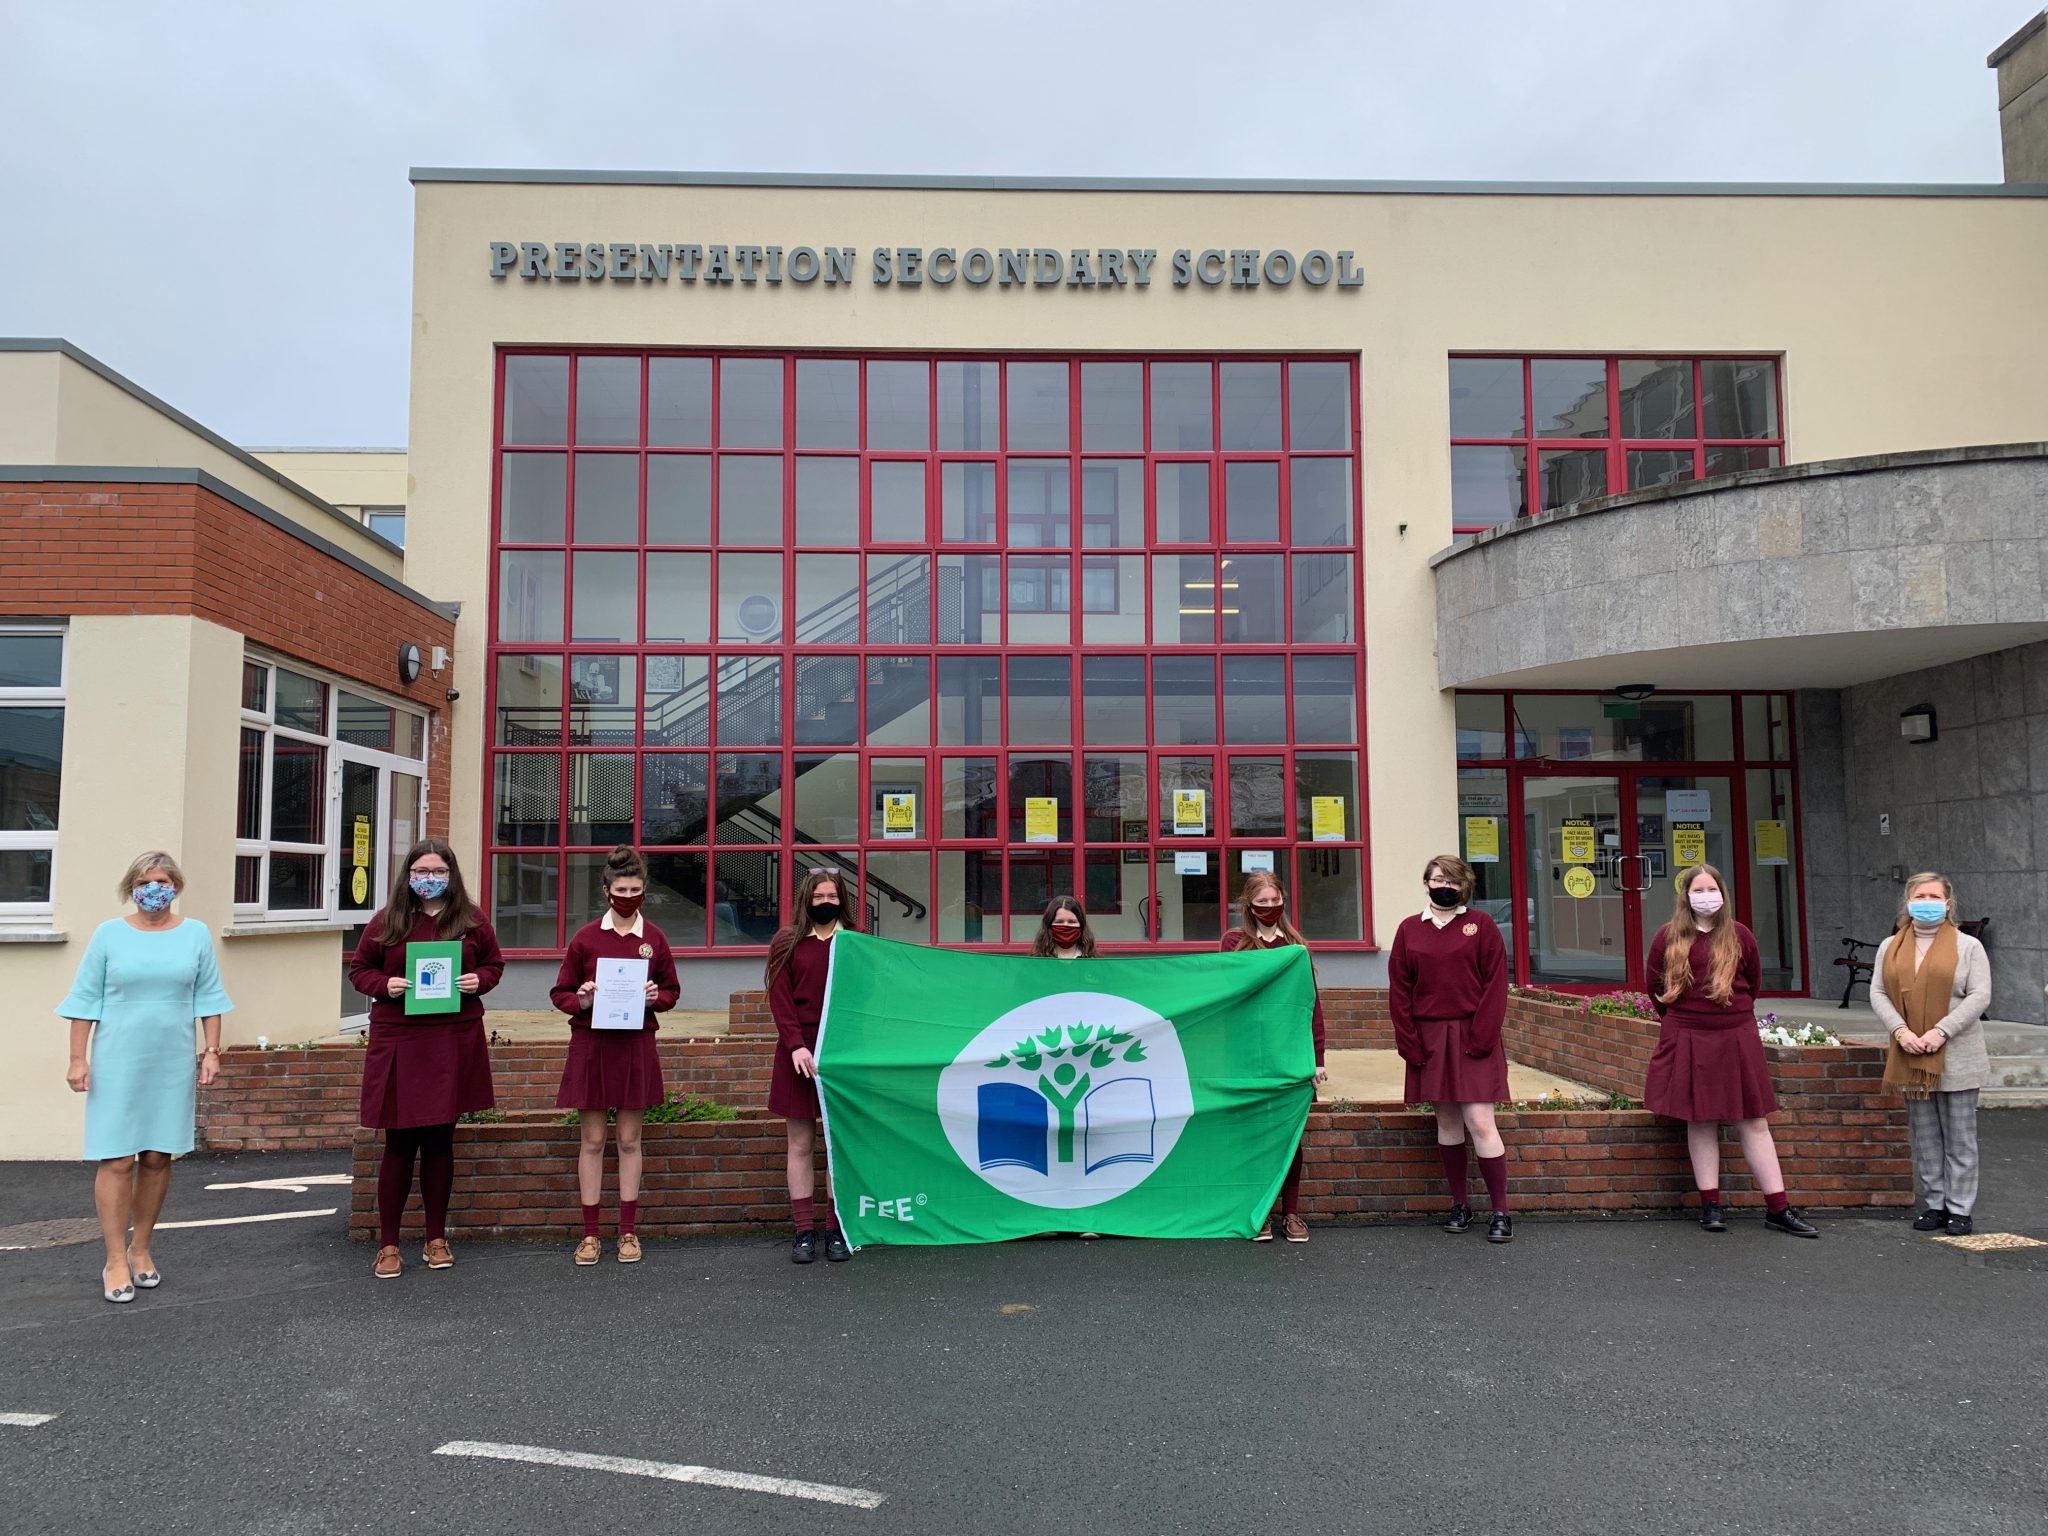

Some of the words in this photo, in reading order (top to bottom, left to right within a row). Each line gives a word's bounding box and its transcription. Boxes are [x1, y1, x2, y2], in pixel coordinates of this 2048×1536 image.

[489, 241, 857, 284] PRESENTATION
[872, 246, 1158, 286] SECONDARY
[1172, 248, 1365, 287] SCHOOL
